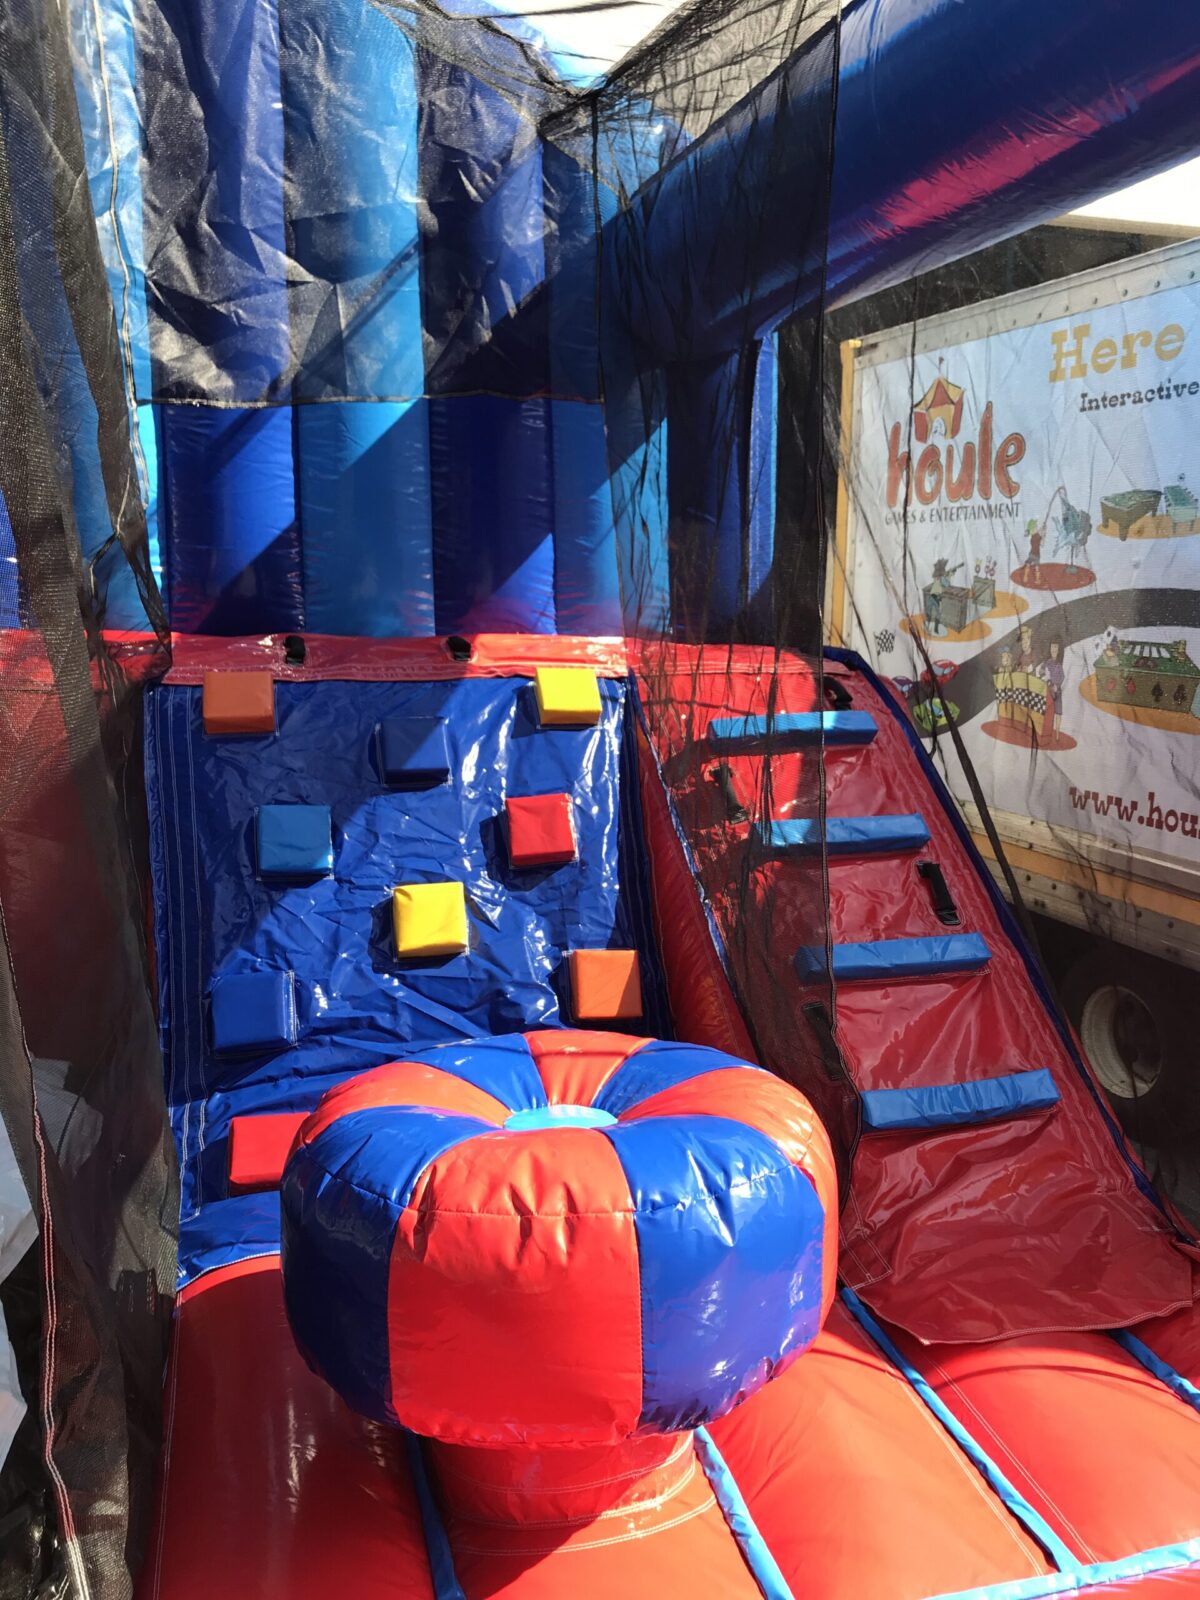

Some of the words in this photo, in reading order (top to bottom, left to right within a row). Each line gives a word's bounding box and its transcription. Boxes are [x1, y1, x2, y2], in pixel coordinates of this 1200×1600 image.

[1048, 323, 1185, 383] Here
[1079, 378, 1200, 412] Interactive
[886, 401, 1026, 508] houle
[919, 510, 926, 523] &
[930, 502, 1021, 523] ENTERTAINMENT
[1069, 786, 1200, 839] www.hou
